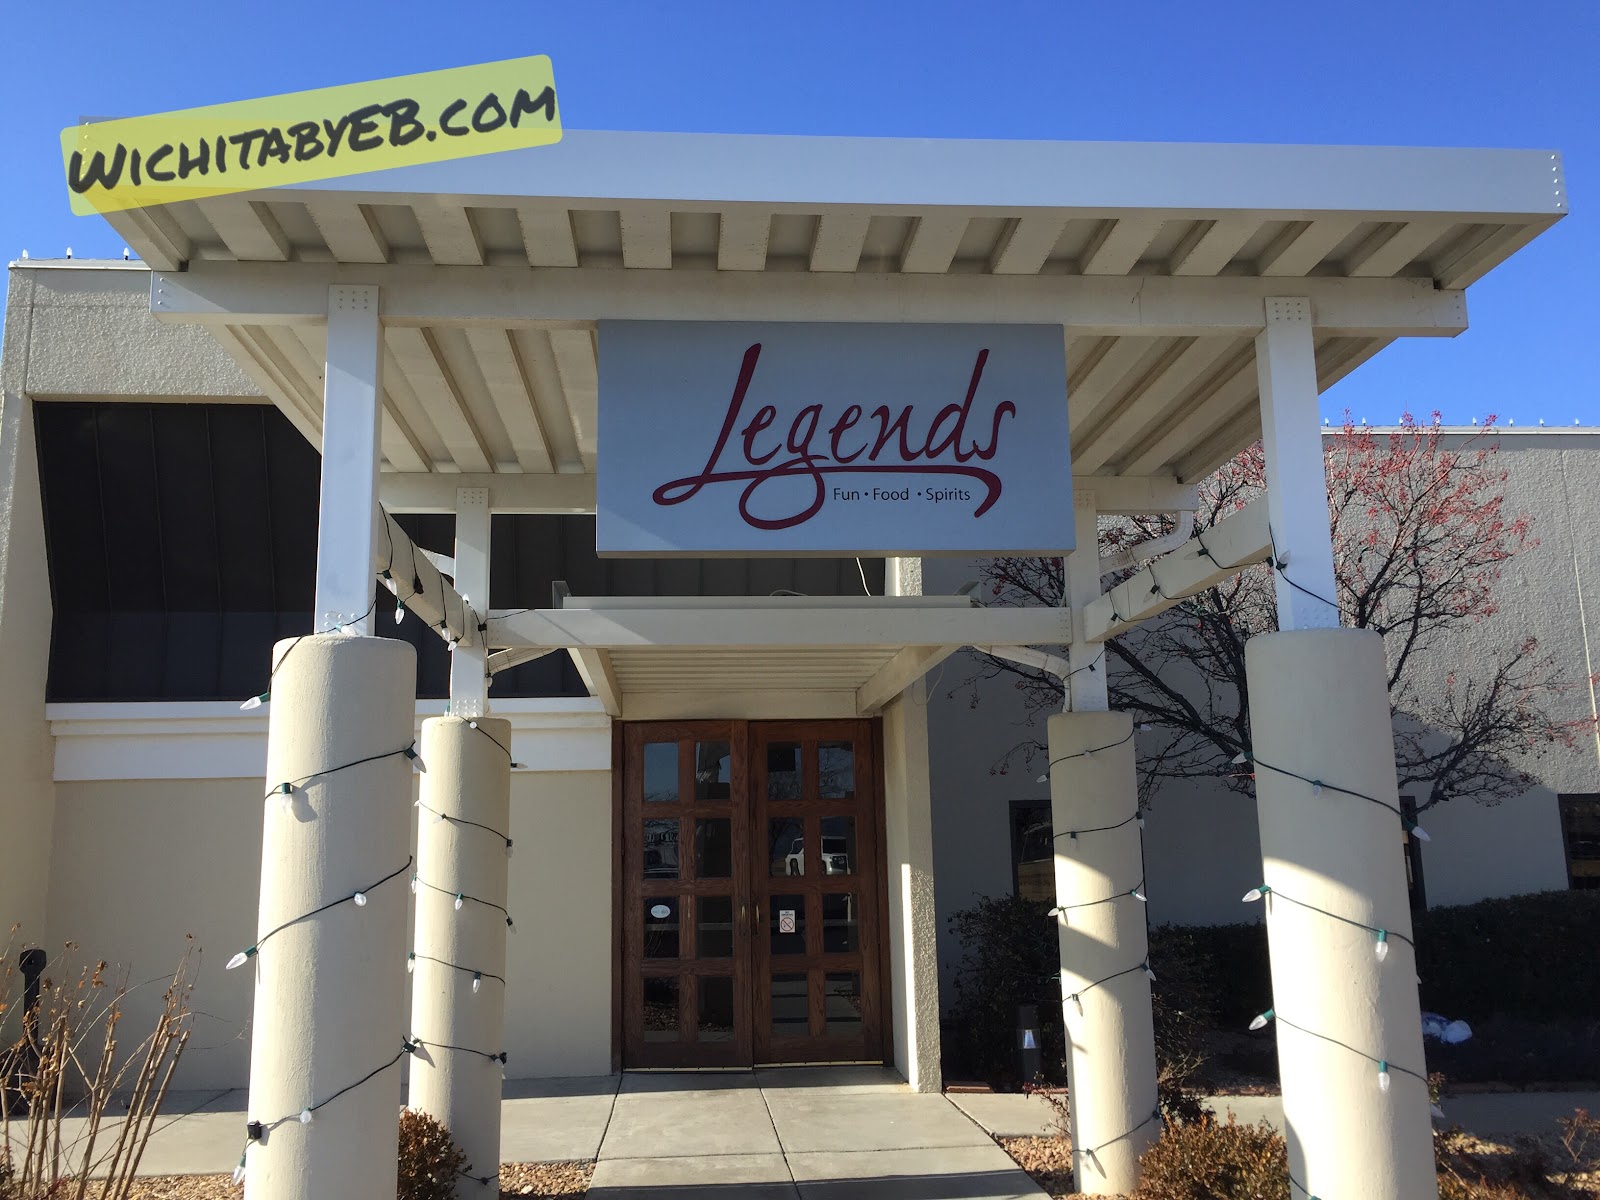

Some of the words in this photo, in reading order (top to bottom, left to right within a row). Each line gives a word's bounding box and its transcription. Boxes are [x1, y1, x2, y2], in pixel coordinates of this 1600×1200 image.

[652, 343, 1016, 530] Legends
[833, 487, 860, 501] Fun
[873, 487, 909, 501] Food
[925, 487, 971, 504] Spirits
